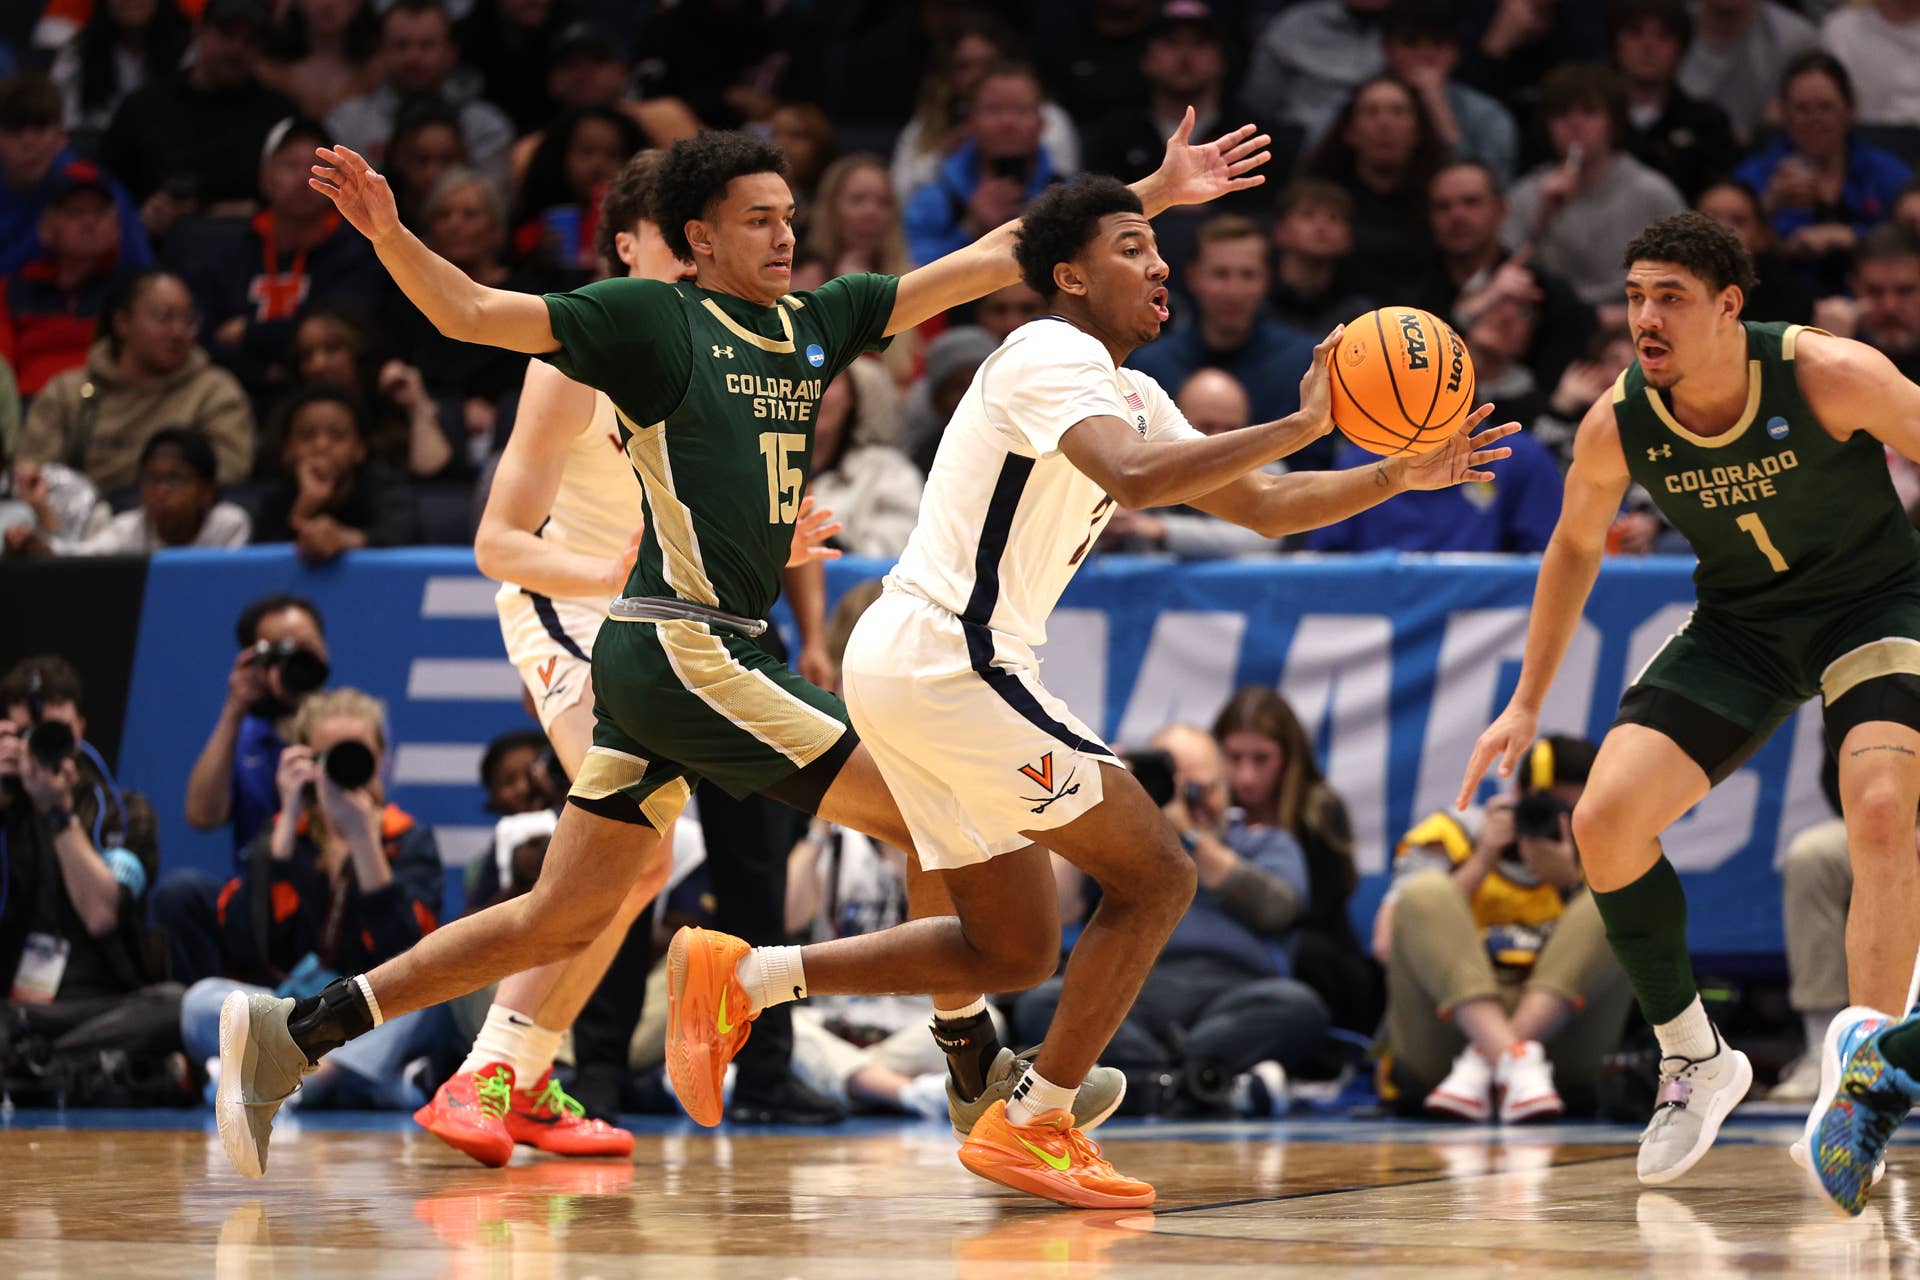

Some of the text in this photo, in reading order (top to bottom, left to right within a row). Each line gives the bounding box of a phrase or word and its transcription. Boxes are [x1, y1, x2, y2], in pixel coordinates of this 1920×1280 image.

[1399, 313, 1429, 370] NCAA
[753, 397, 814, 421] STATE
[759, 432, 807, 524] 15
[1664, 450, 1799, 494] COLORADO
[1699, 478, 1777, 509] STATE
[1736, 512, 1790, 572] 1
[1016, 750, 1053, 794] V
